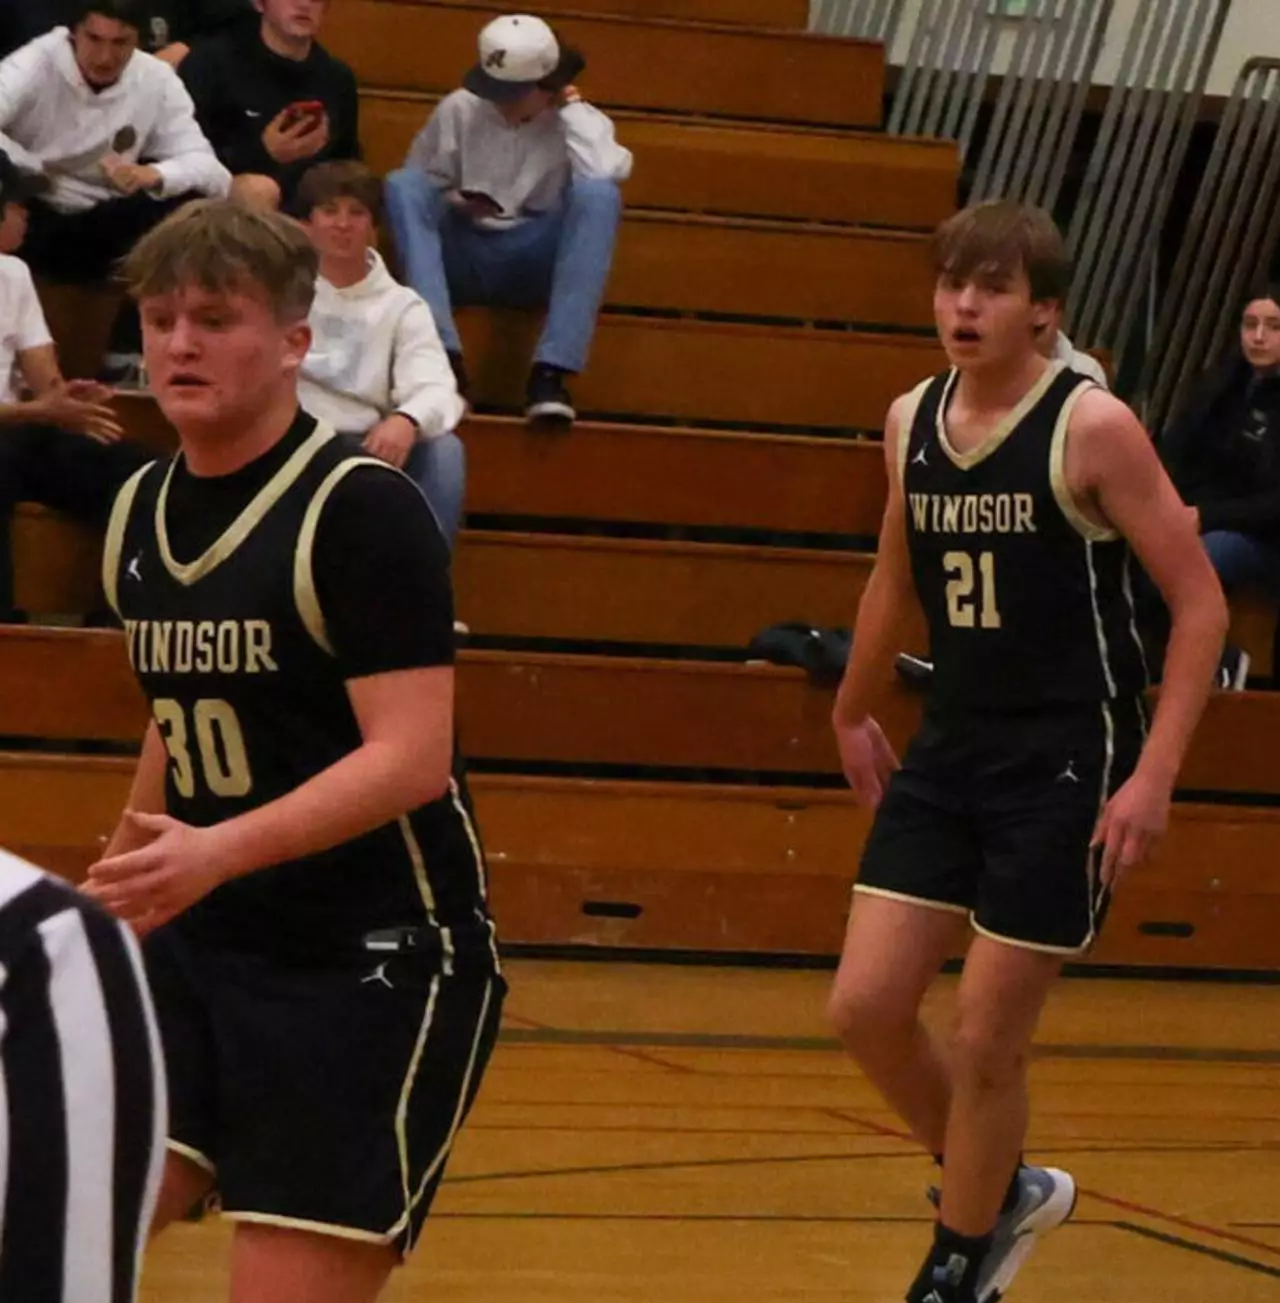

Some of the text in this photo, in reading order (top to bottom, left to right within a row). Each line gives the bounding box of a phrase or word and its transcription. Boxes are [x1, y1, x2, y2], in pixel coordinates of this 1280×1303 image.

[908, 492, 1038, 534] WINDSOR
[942, 551, 1002, 629] 21
[153, 698, 252, 797] 30
